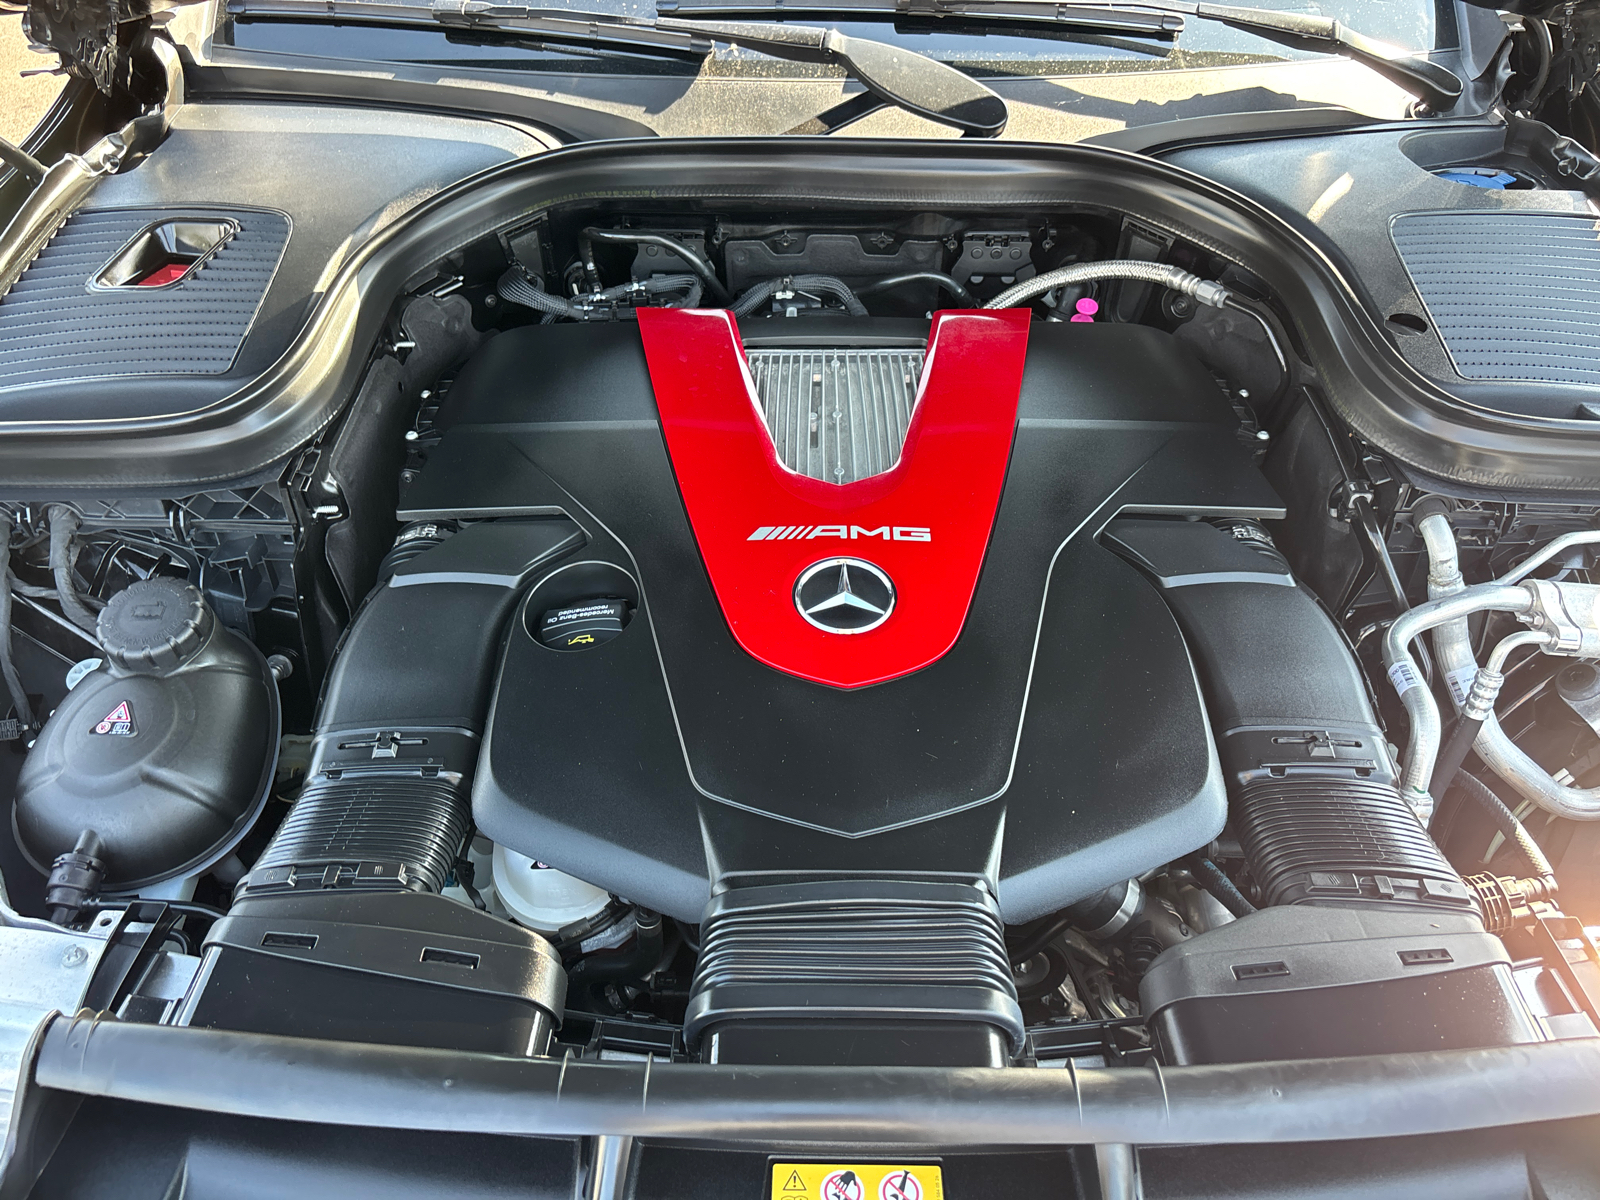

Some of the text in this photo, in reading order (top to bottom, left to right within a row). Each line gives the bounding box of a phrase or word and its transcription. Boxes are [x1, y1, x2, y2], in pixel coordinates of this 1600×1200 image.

[805, 525, 932, 542] AMG
[558, 604, 609, 616] recommended
[559, 609, 615, 621] Mercedes-Benz
